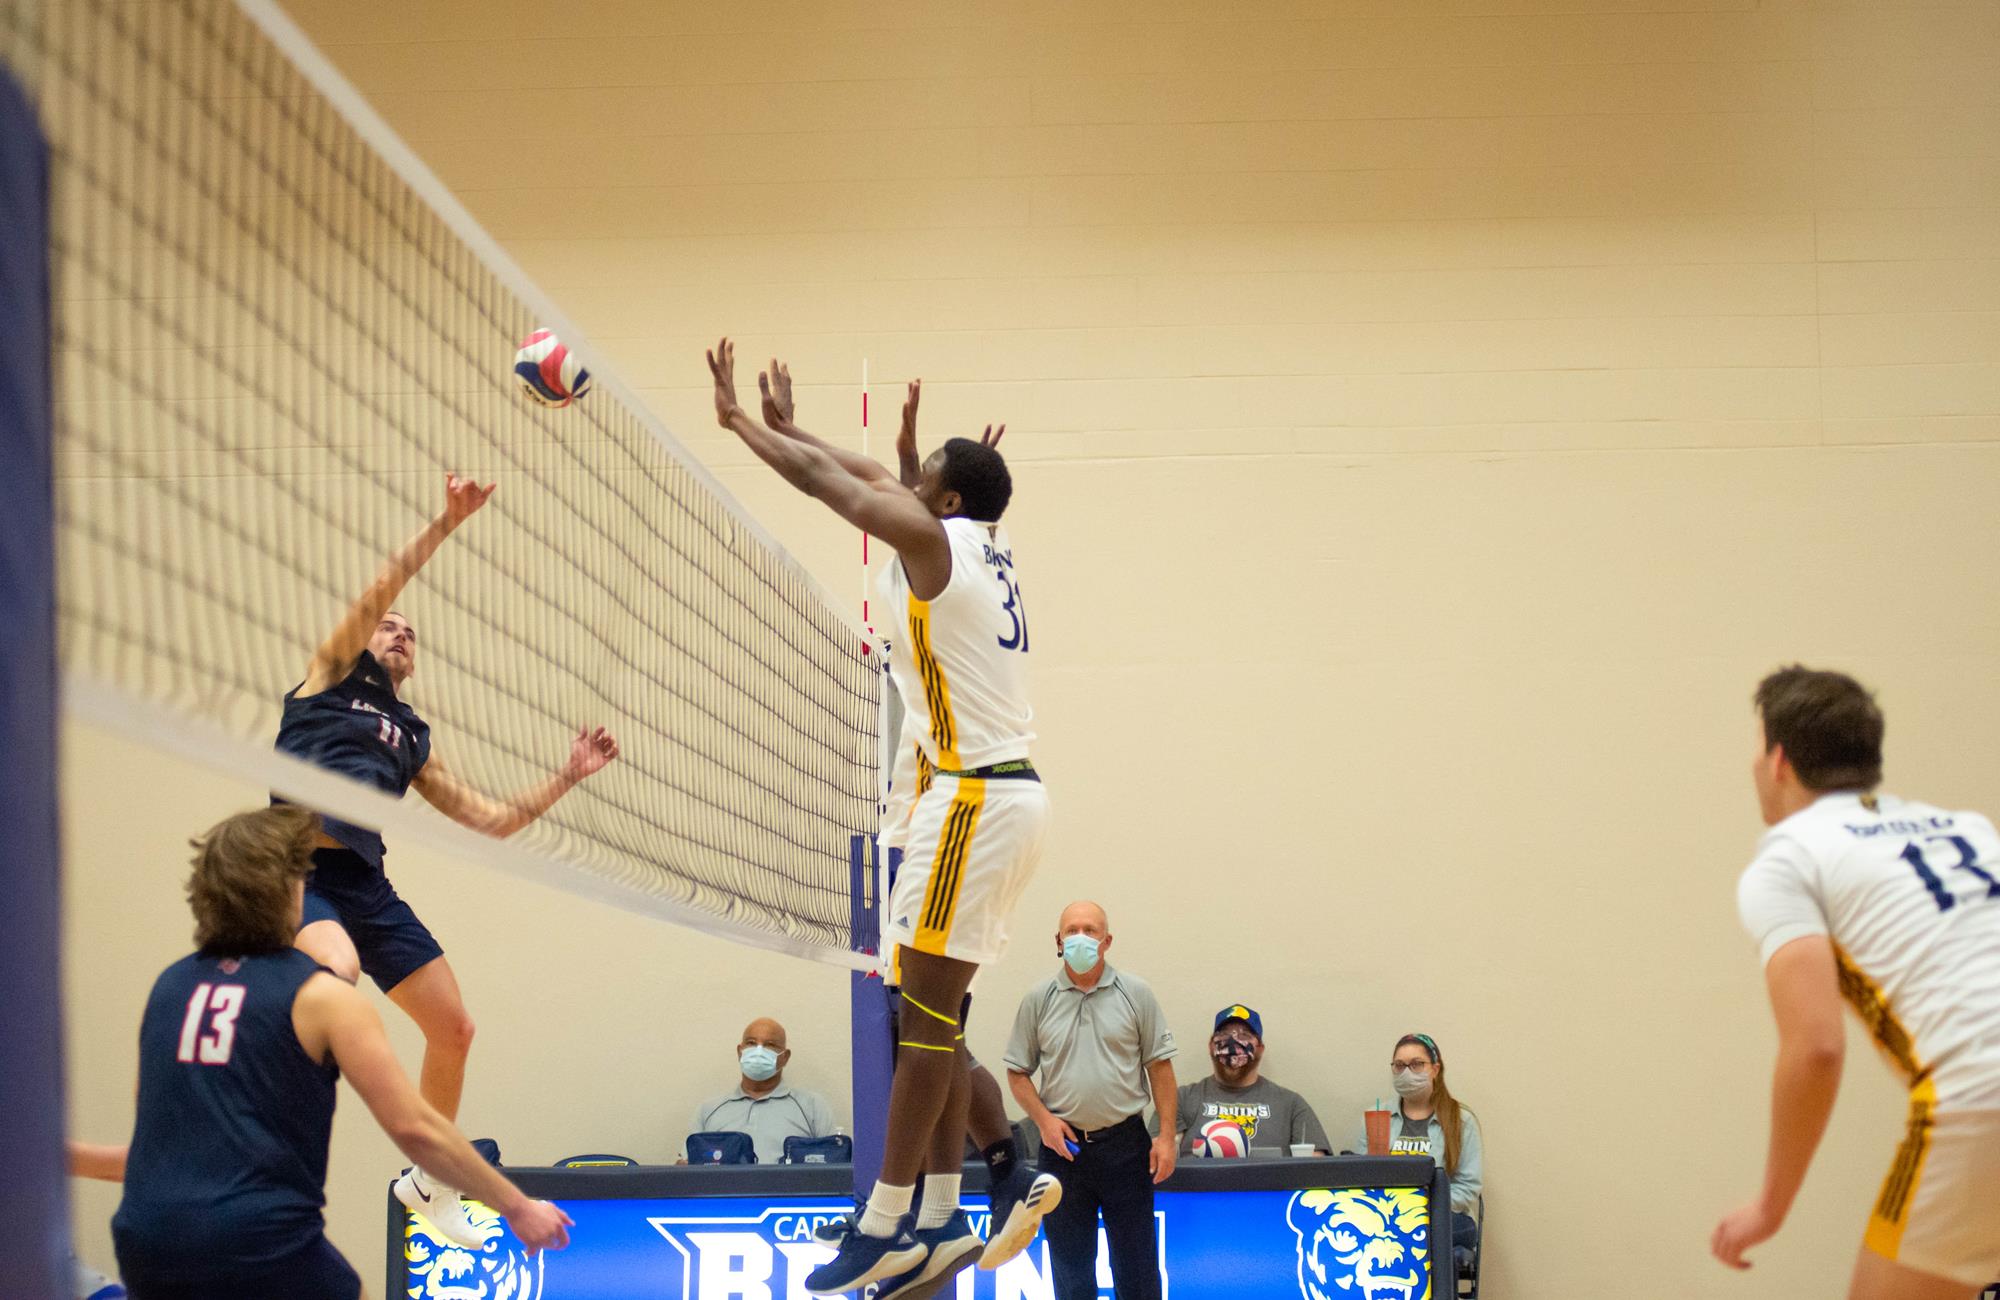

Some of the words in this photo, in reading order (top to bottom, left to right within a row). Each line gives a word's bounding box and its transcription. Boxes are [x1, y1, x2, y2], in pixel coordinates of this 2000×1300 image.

[997, 570, 1029, 653] 31
[176, 981, 248, 1067] 13
[1205, 1103, 1269, 1118] BRUINS
[1391, 1139, 1432, 1153] RUIN
